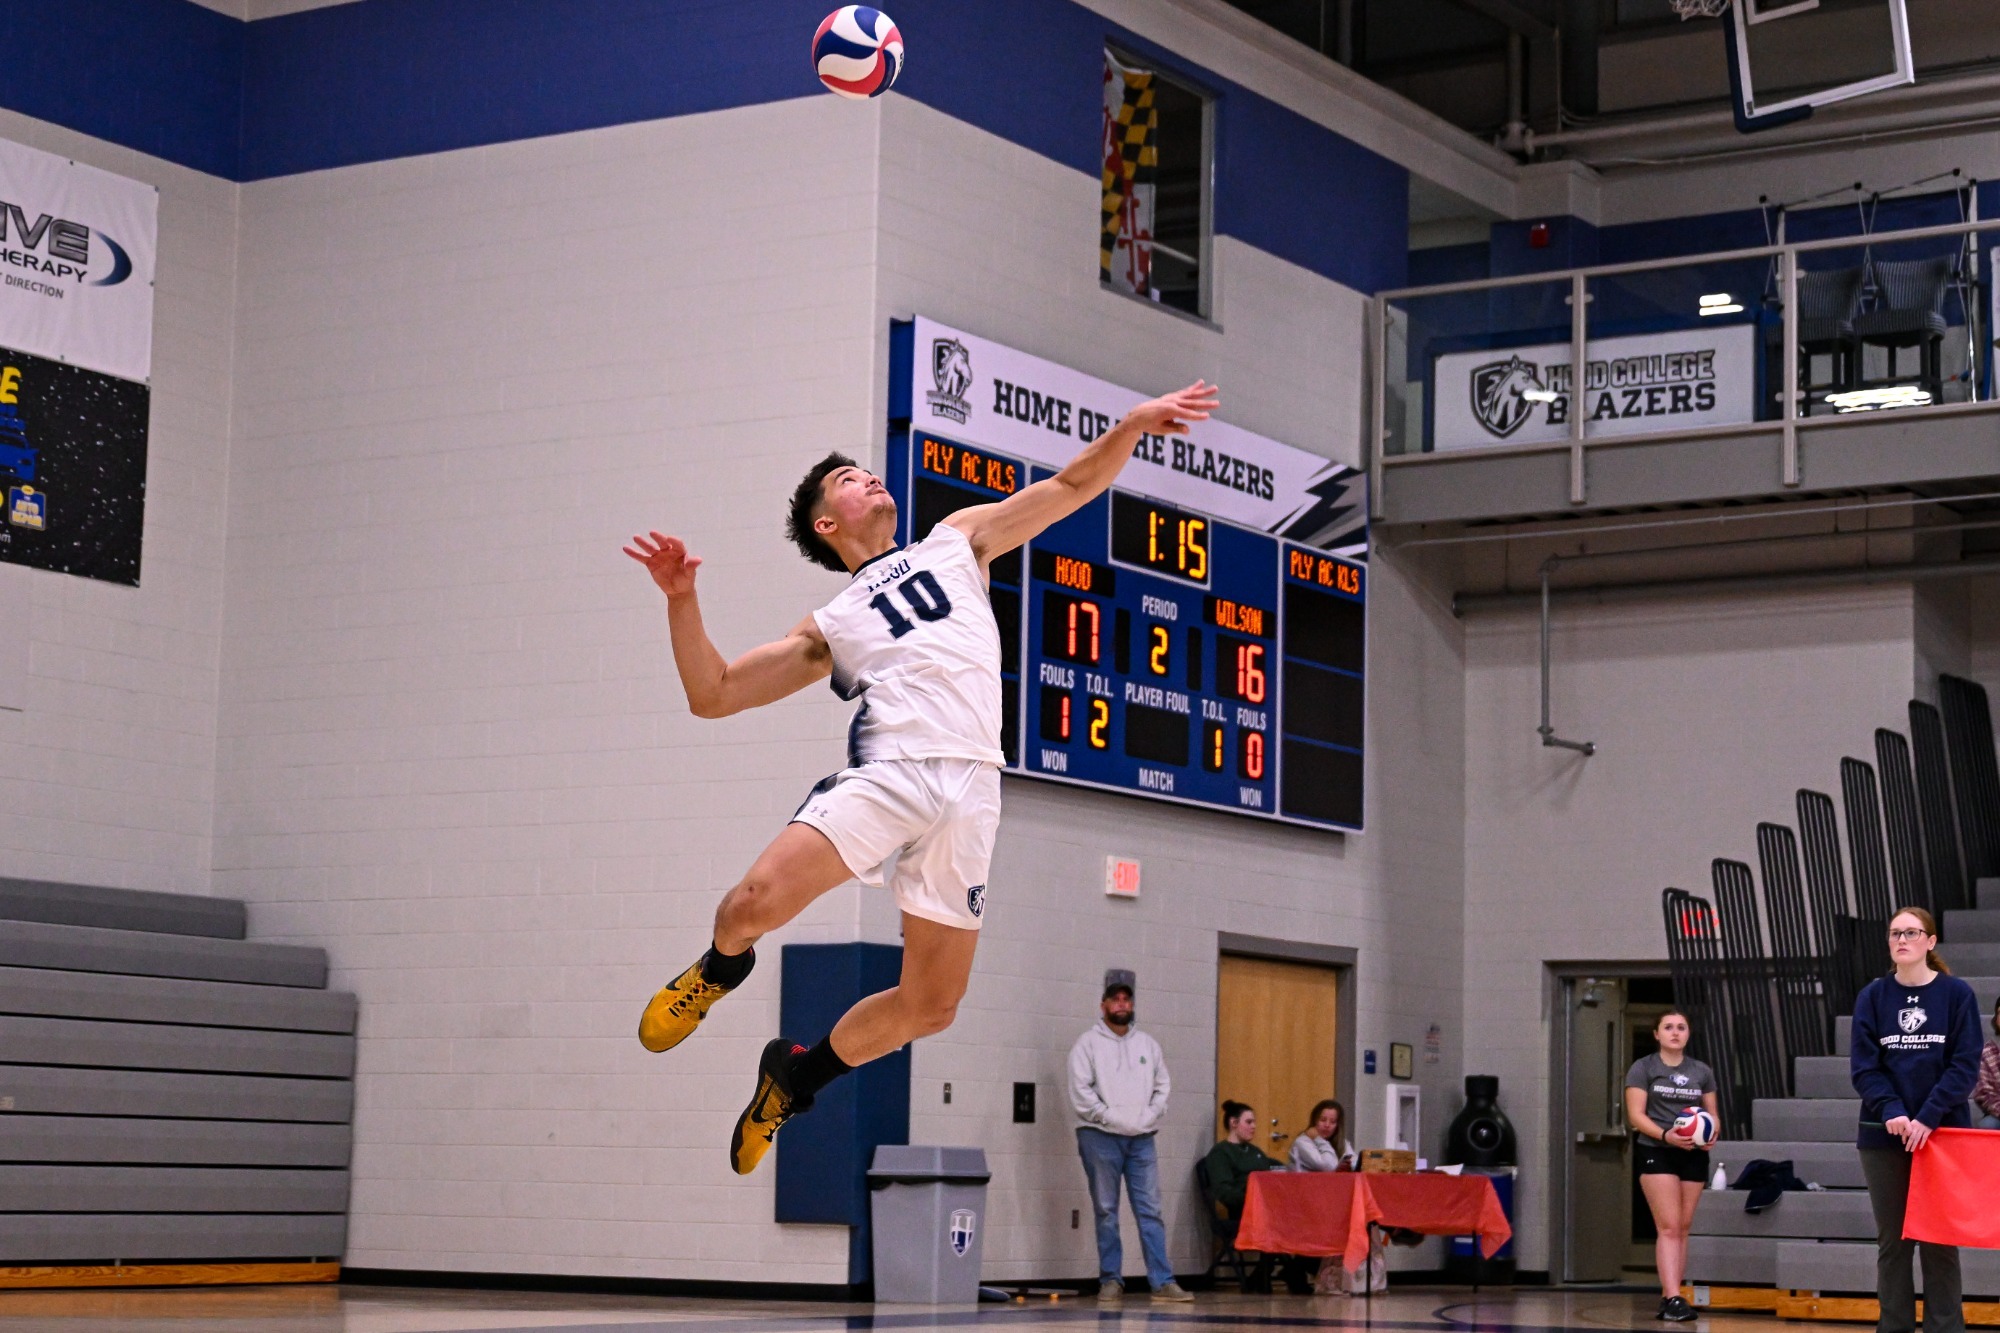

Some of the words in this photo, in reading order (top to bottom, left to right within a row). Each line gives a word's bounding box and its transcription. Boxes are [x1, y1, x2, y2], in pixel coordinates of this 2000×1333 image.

[5, 274, 64, 299] DIRECTION
[1610, 349, 1716, 387] COLLEGE
[1545, 382, 1716, 425] BAZERS
[993, 377, 1072, 436] HOME
[1171, 438, 1275, 502] BLAZERS
[923, 439, 954, 475] PLY
[961, 451, 981, 484] AC
[986, 458, 1016, 494] KLS
[1149, 511, 1207, 579] 1:15
[1055, 555, 1092, 591] HOOD
[1290, 550, 1314, 581] PLY
[1318, 559, 1334, 587] AC
[1337, 564, 1359, 595] KLS
[868, 569, 953, 641] 10
[1142, 594, 1178, 621] PERIOD
[1216, 599, 1263, 636] WILSON
[1068, 602, 1099, 661] 17
[1151, 626, 1168, 674] 2
[1040, 663, 1075, 689] FOULS
[1085, 672, 1114, 697] T.O.L.
[1238, 644, 1265, 703] 16
[1062, 696, 1070, 738] 1
[1125, 682, 1163, 708] PLAYER
[1166, 691, 1191, 714] FOUL
[1202, 699, 1227, 722] T.O.L.
[1090, 699, 1109, 748] 2
[1237, 707, 1266, 730] FOULS
[1041, 749, 1067, 772] WON
[1214, 728, 1222, 768] 1
[1246, 732, 1263, 779] 0
[1138, 767, 1174, 791] MATCH
[1240, 787, 1262, 807] WON
[1902, 1034, 1946, 1043] COLLEGE
